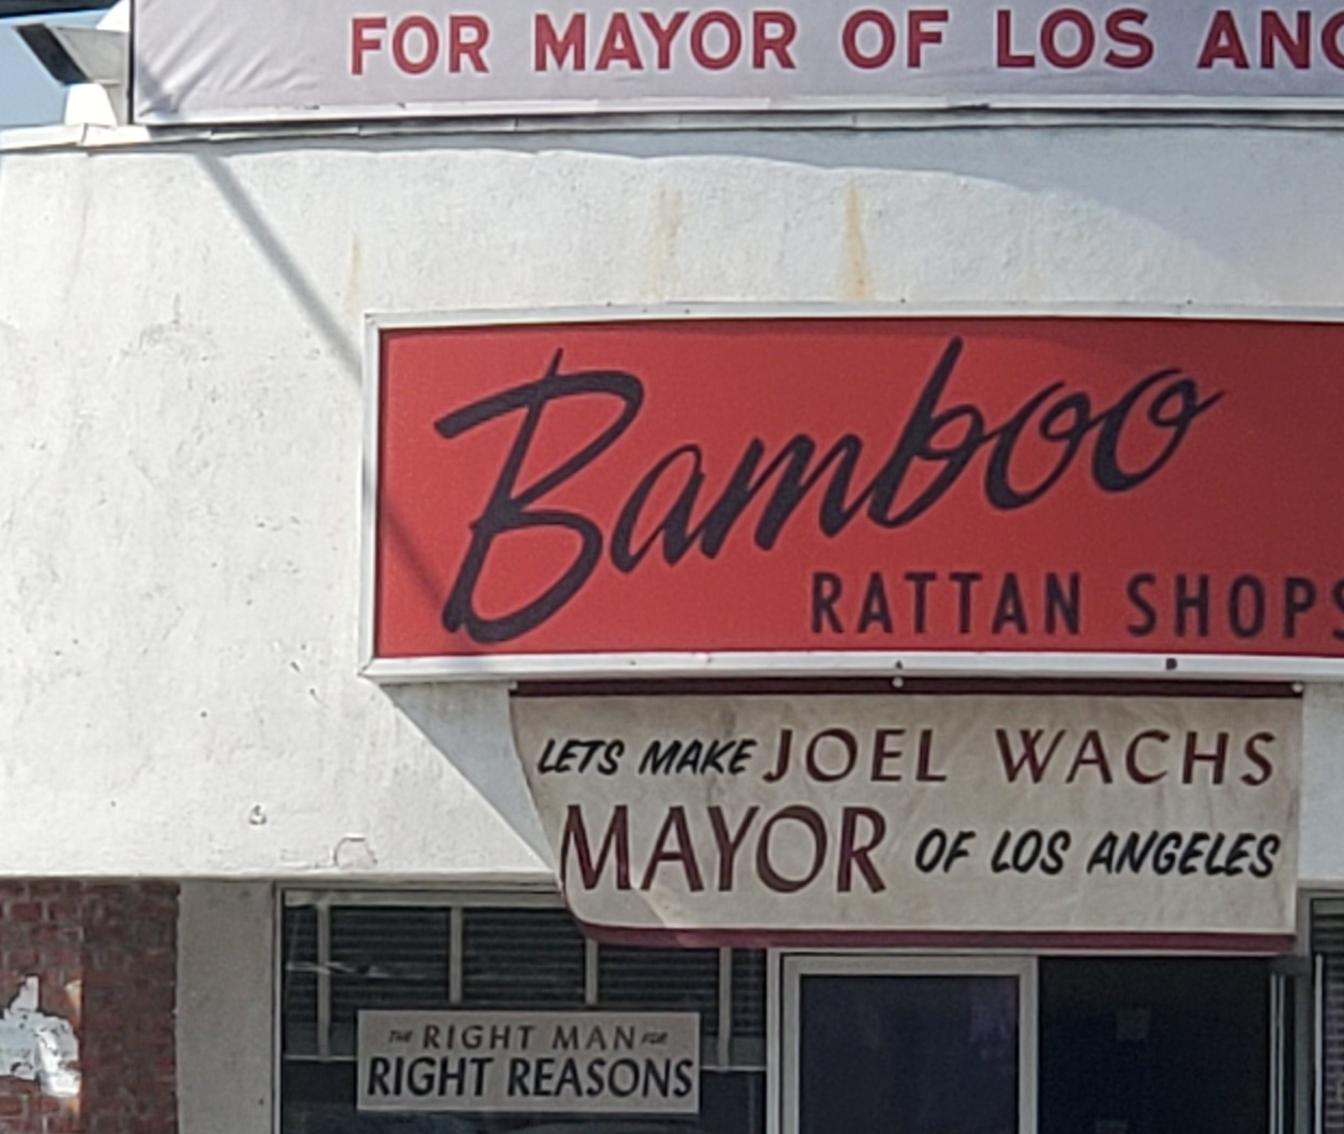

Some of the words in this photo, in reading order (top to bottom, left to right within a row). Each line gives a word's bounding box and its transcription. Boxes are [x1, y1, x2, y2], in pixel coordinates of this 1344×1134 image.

[351, 15, 489, 75] FOR
[535, 10, 796, 71] MAYOR
[843, 9, 949, 69] OF
[996, 9, 1153, 68] LOS
[433, 335, 1224, 644] Bamboo
[811, 572, 1082, 634] RATTAN
[538, 738, 625, 775] LETS
[638, 738, 758, 775] MAKE
[762, 727, 947, 783] JOEL
[994, 728, 1276, 786] WACHS
[561, 803, 887, 893] MAYOR
[914, 827, 976, 873] OF
[990, 828, 1071, 875] LOS
[1087, 830, 1281, 878] ANGELES
[423, 1025, 535, 1051] RIGHT
[552, 1025, 636, 1051] MAN
[367, 1056, 495, 1097] RIGHT
[507, 1058, 694, 1098] REASONS
